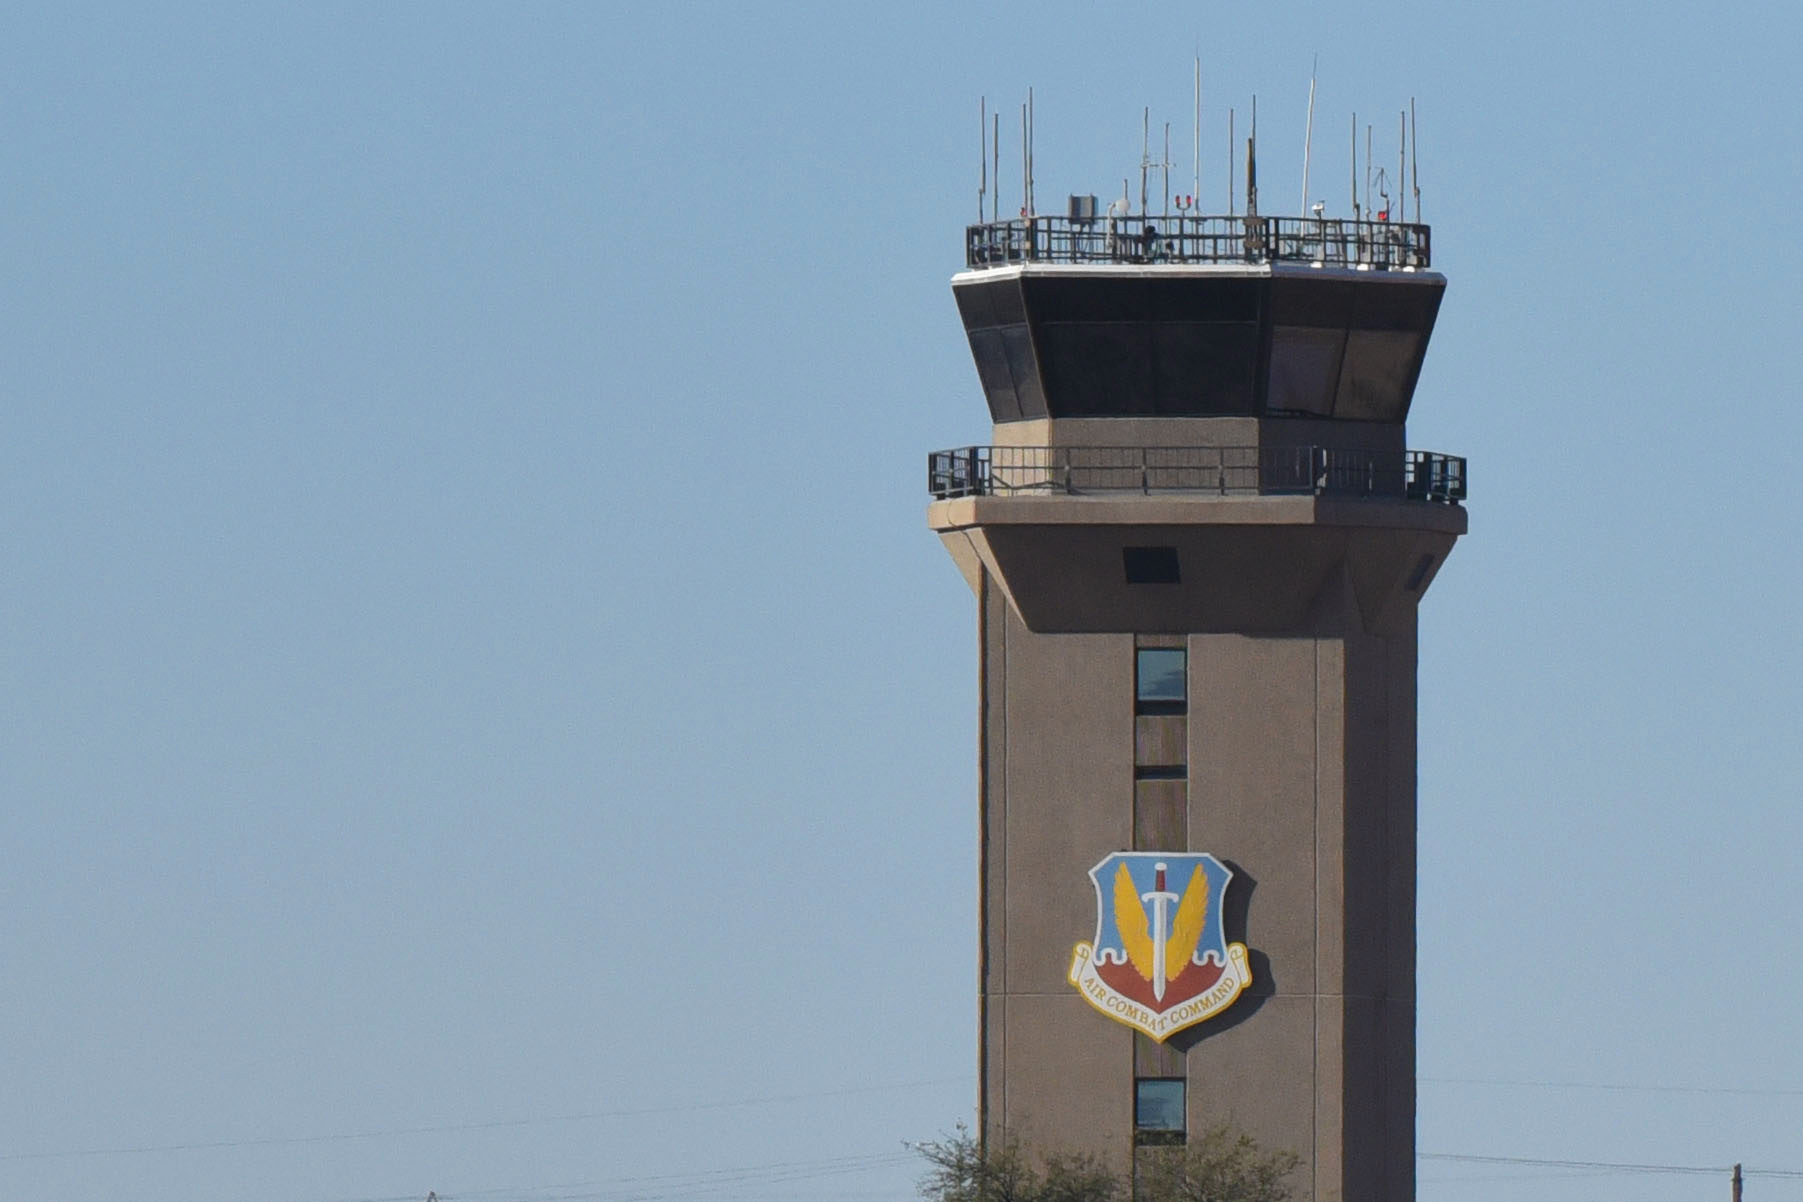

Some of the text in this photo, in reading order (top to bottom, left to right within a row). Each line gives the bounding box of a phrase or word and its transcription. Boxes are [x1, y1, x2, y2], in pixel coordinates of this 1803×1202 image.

[1084, 977, 1235, 1031] AIR COMBAT COMMAND
